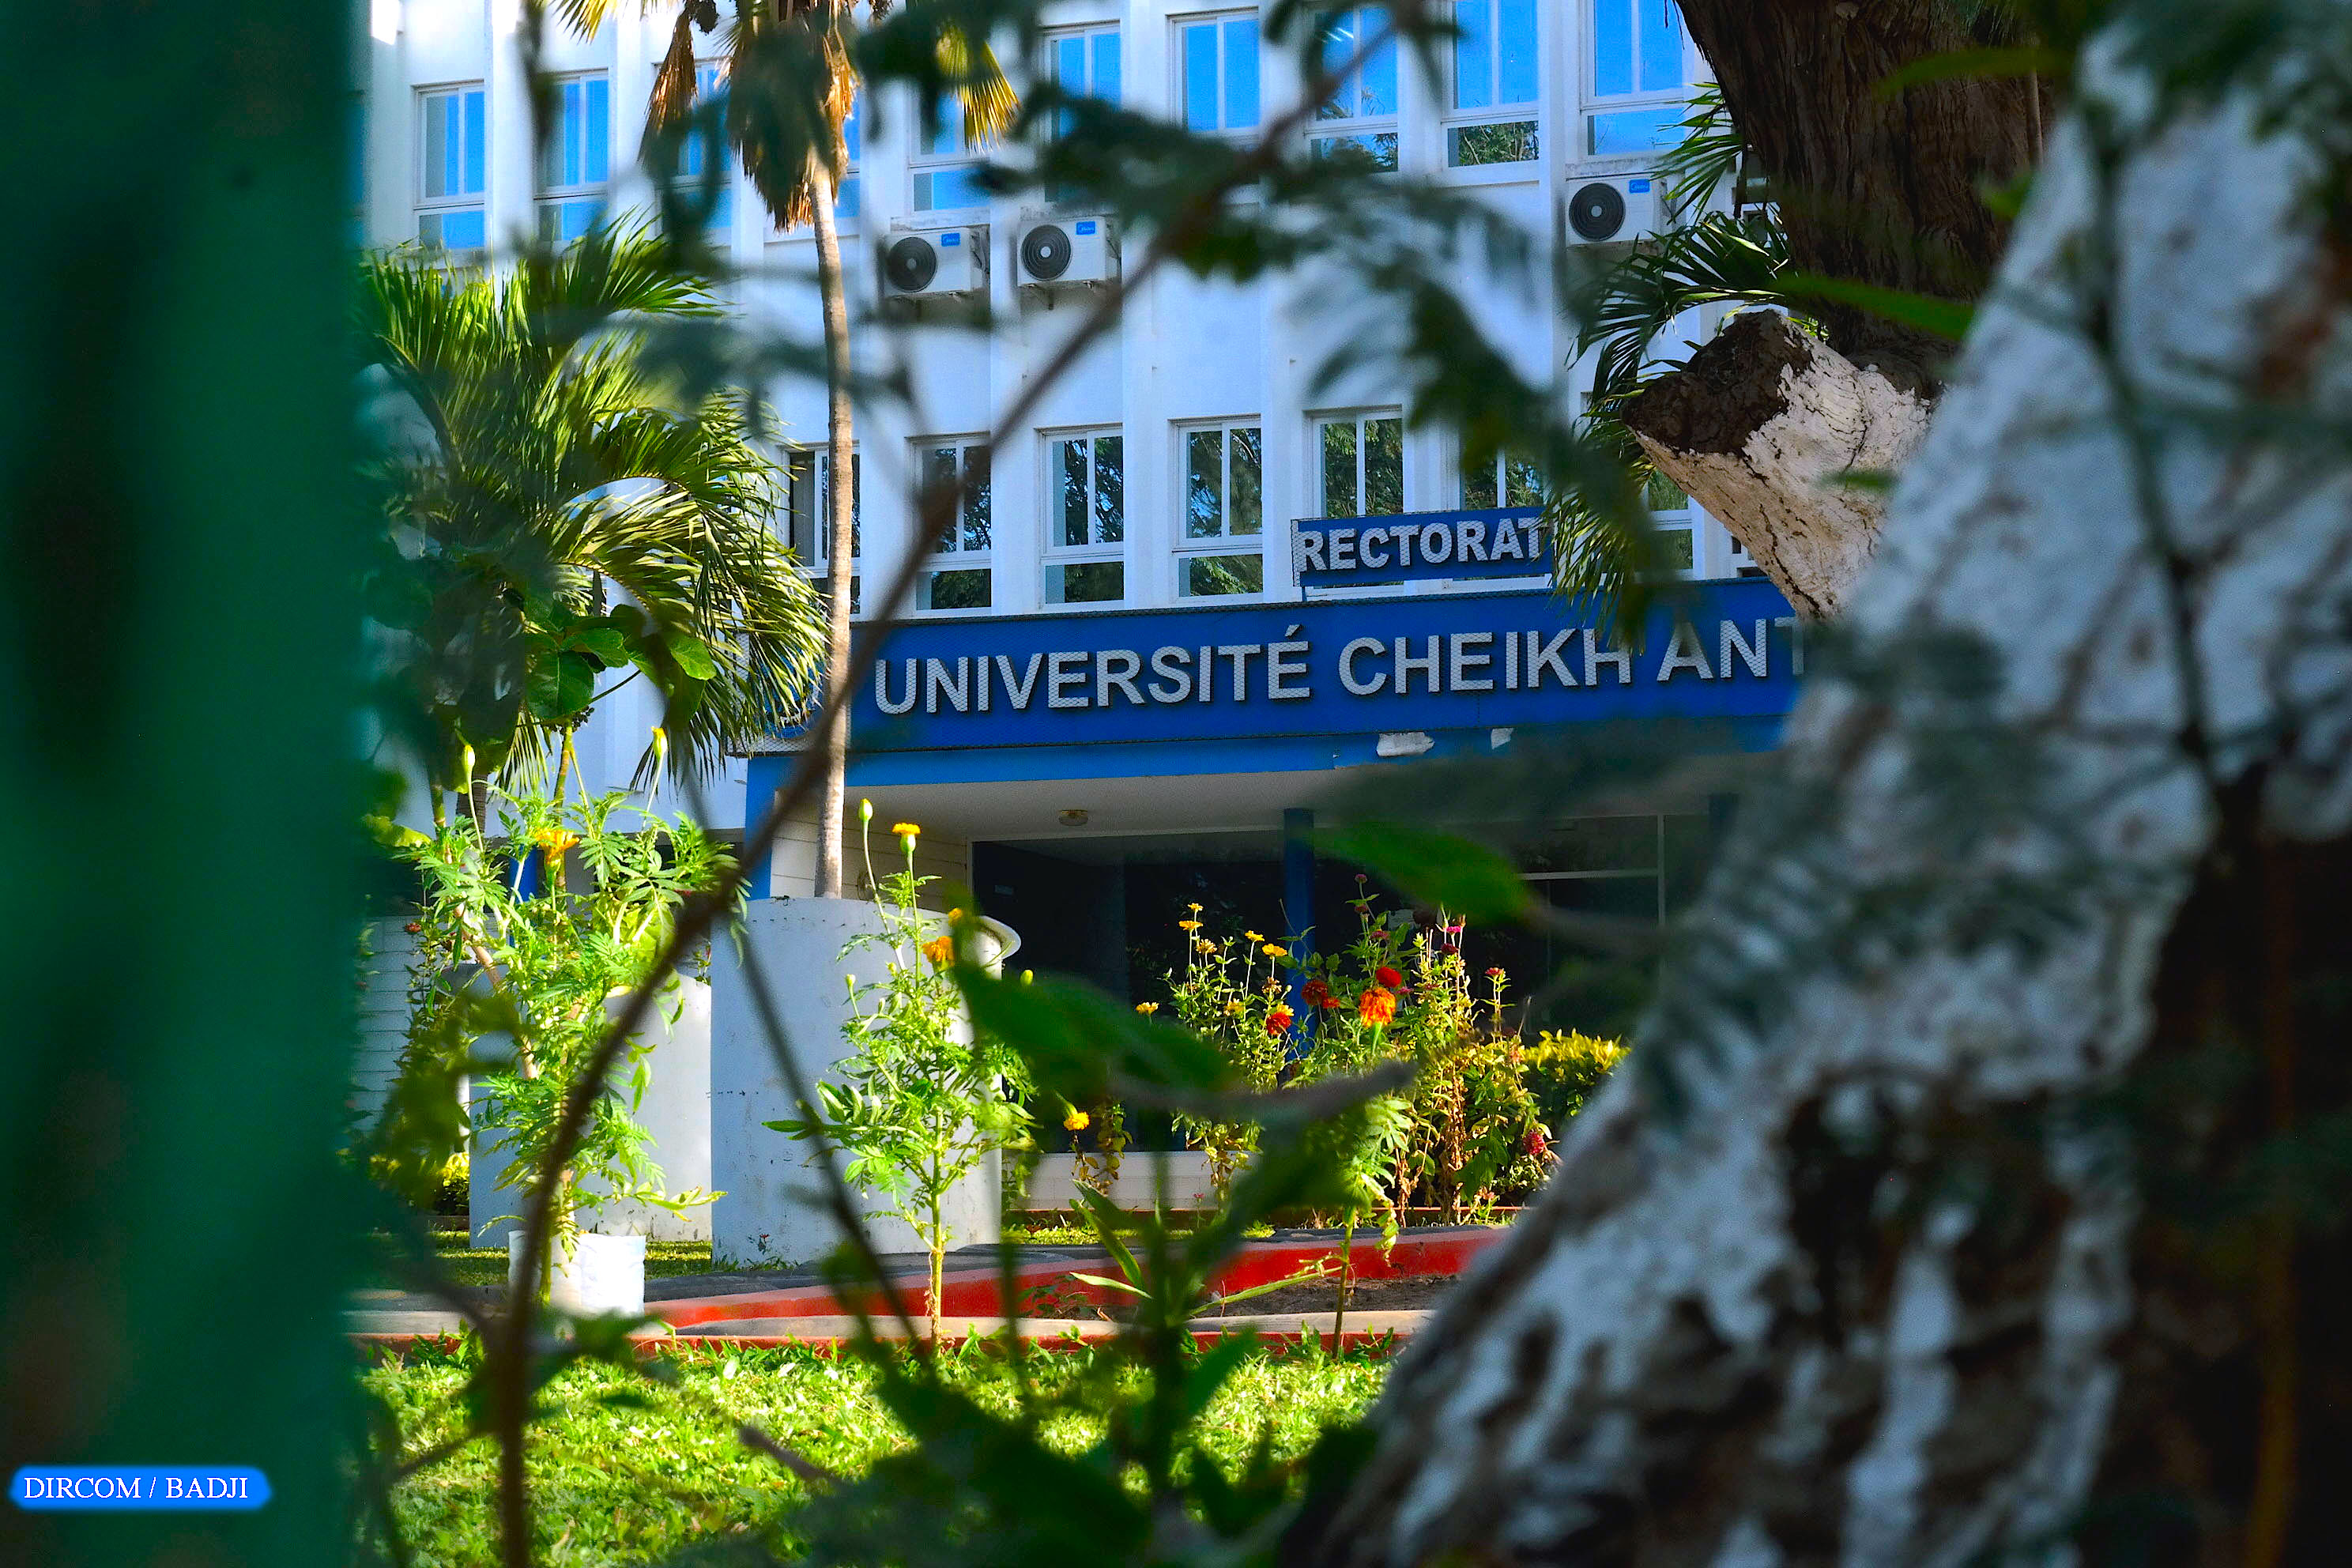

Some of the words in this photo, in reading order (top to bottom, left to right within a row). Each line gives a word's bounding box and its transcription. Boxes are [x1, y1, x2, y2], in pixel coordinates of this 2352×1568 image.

[1294, 517, 1544, 572] RECTORAT
[874, 624, 1311, 714] UNIVERSITÉ
[1338, 628, 1632, 696] CHEIKH
